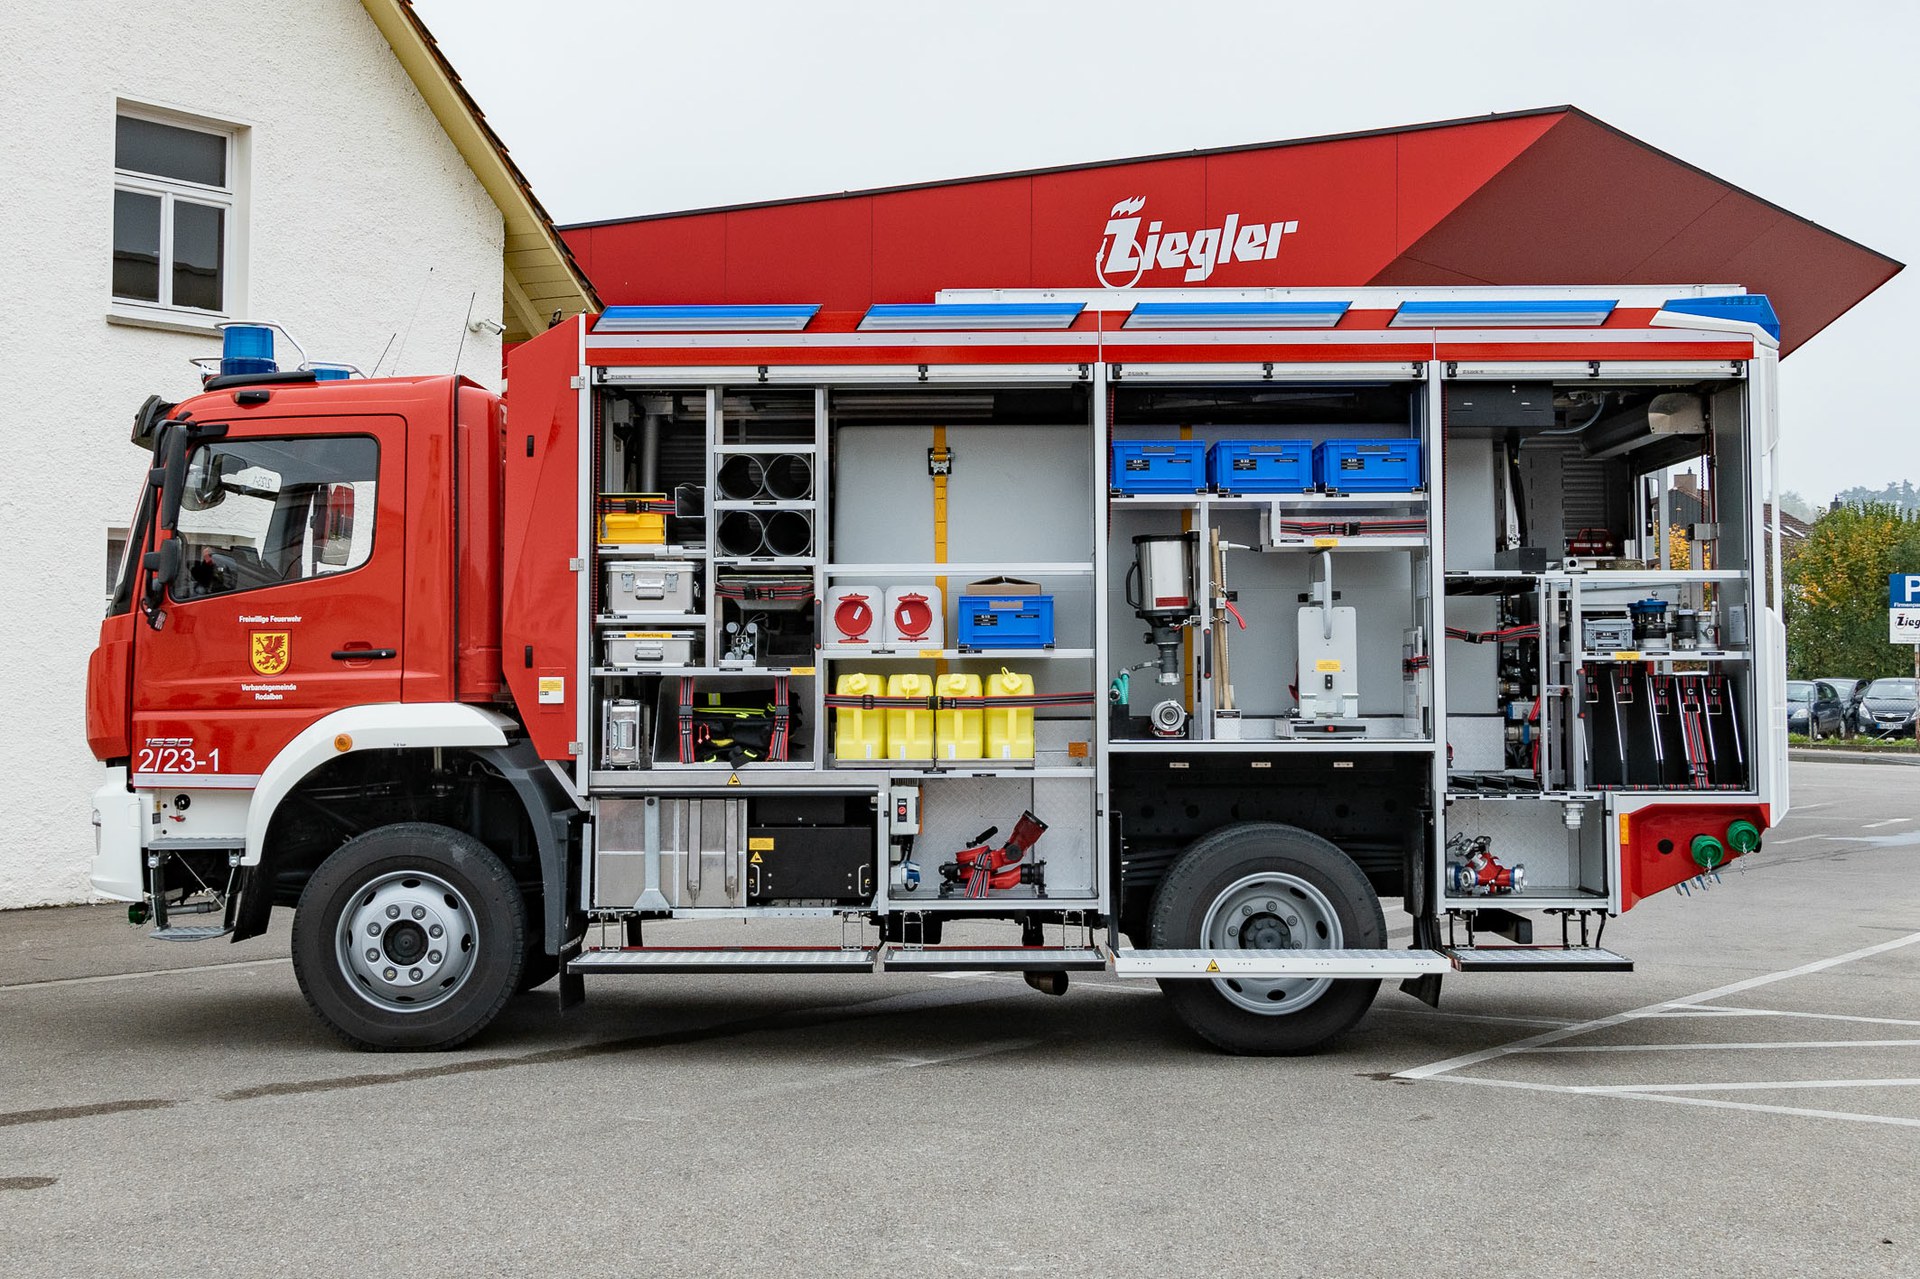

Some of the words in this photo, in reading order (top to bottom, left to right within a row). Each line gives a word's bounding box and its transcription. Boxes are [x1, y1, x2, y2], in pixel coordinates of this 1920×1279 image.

[1102, 212, 1299, 283] Ziegler
[1905, 575, 1920, 602] P
[239, 615, 269, 624] Freiwillige
[270, 615, 302, 623] Feuerwehr
[241, 684, 297, 692] Verbandsgemeinde
[145, 737, 194, 748] 1530
[137, 747, 219, 773] 2/23-1
